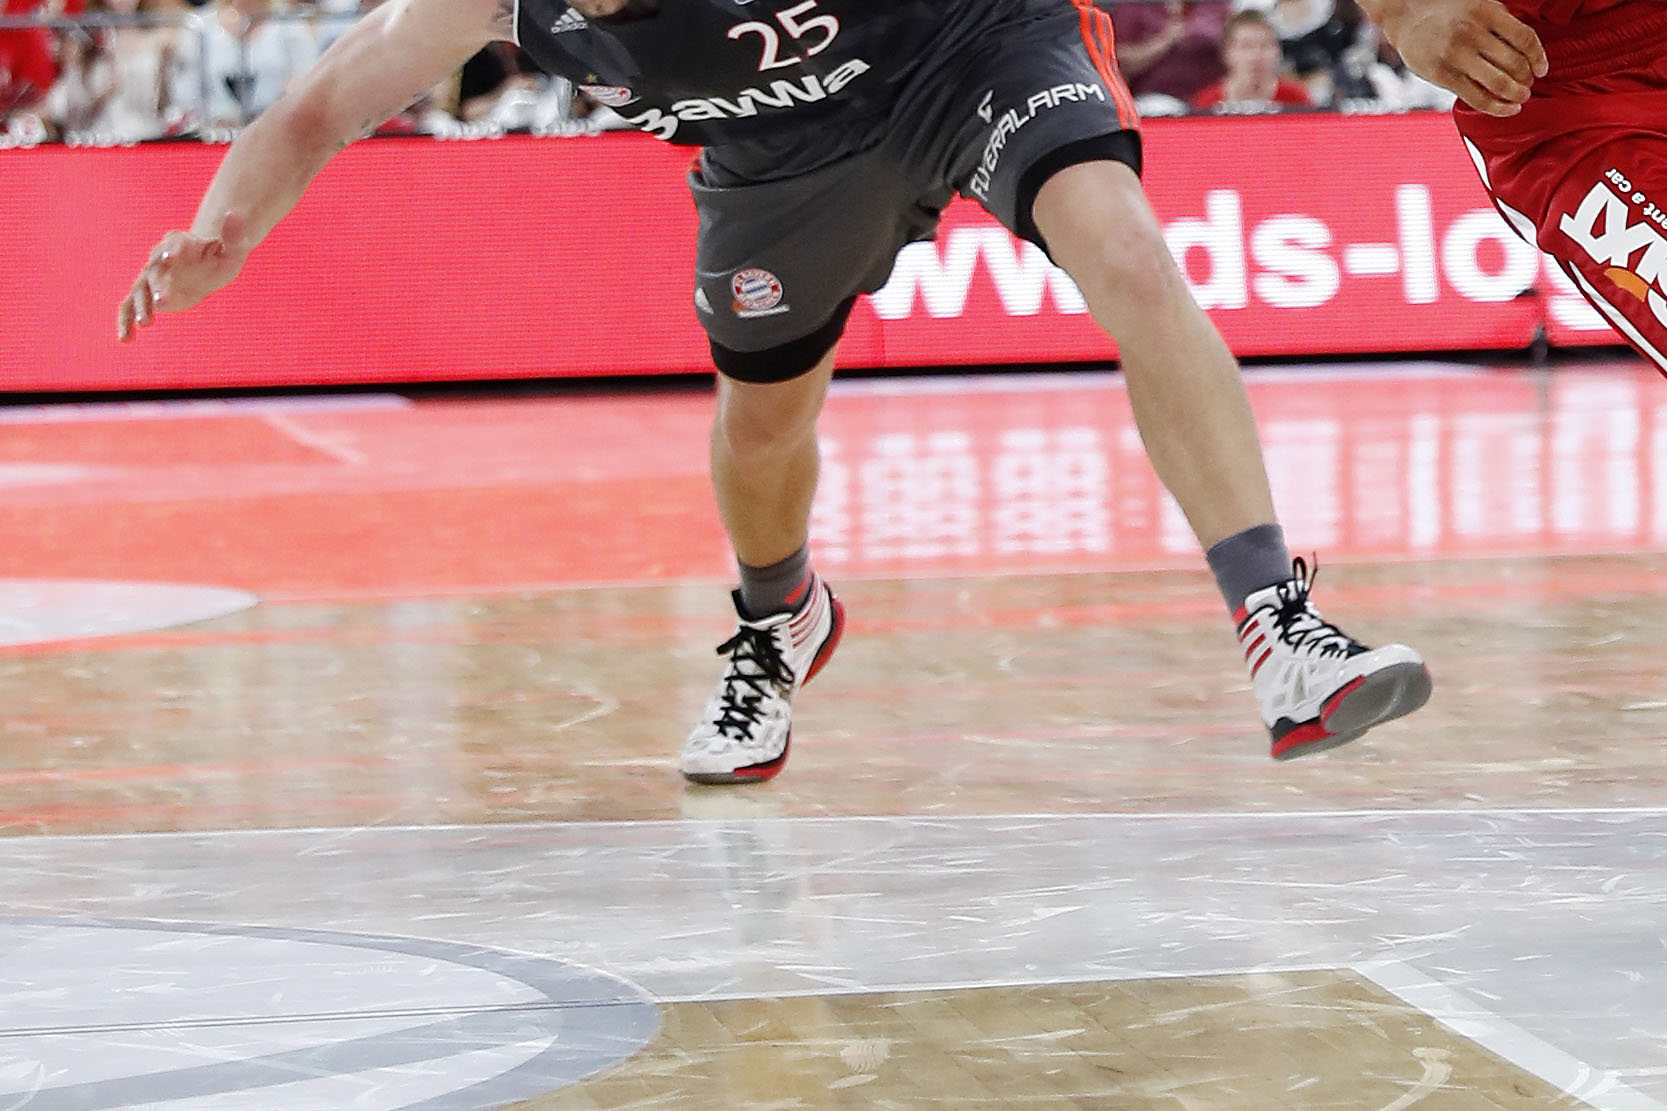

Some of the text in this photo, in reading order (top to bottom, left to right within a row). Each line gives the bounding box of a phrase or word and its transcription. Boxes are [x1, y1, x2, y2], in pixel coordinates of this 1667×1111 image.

[727, 0, 840, 72] 25
[969, 83, 1106, 203] FLYERALARM
[1605, 168, 1632, 193] car
[1631, 191, 1646, 204] a
